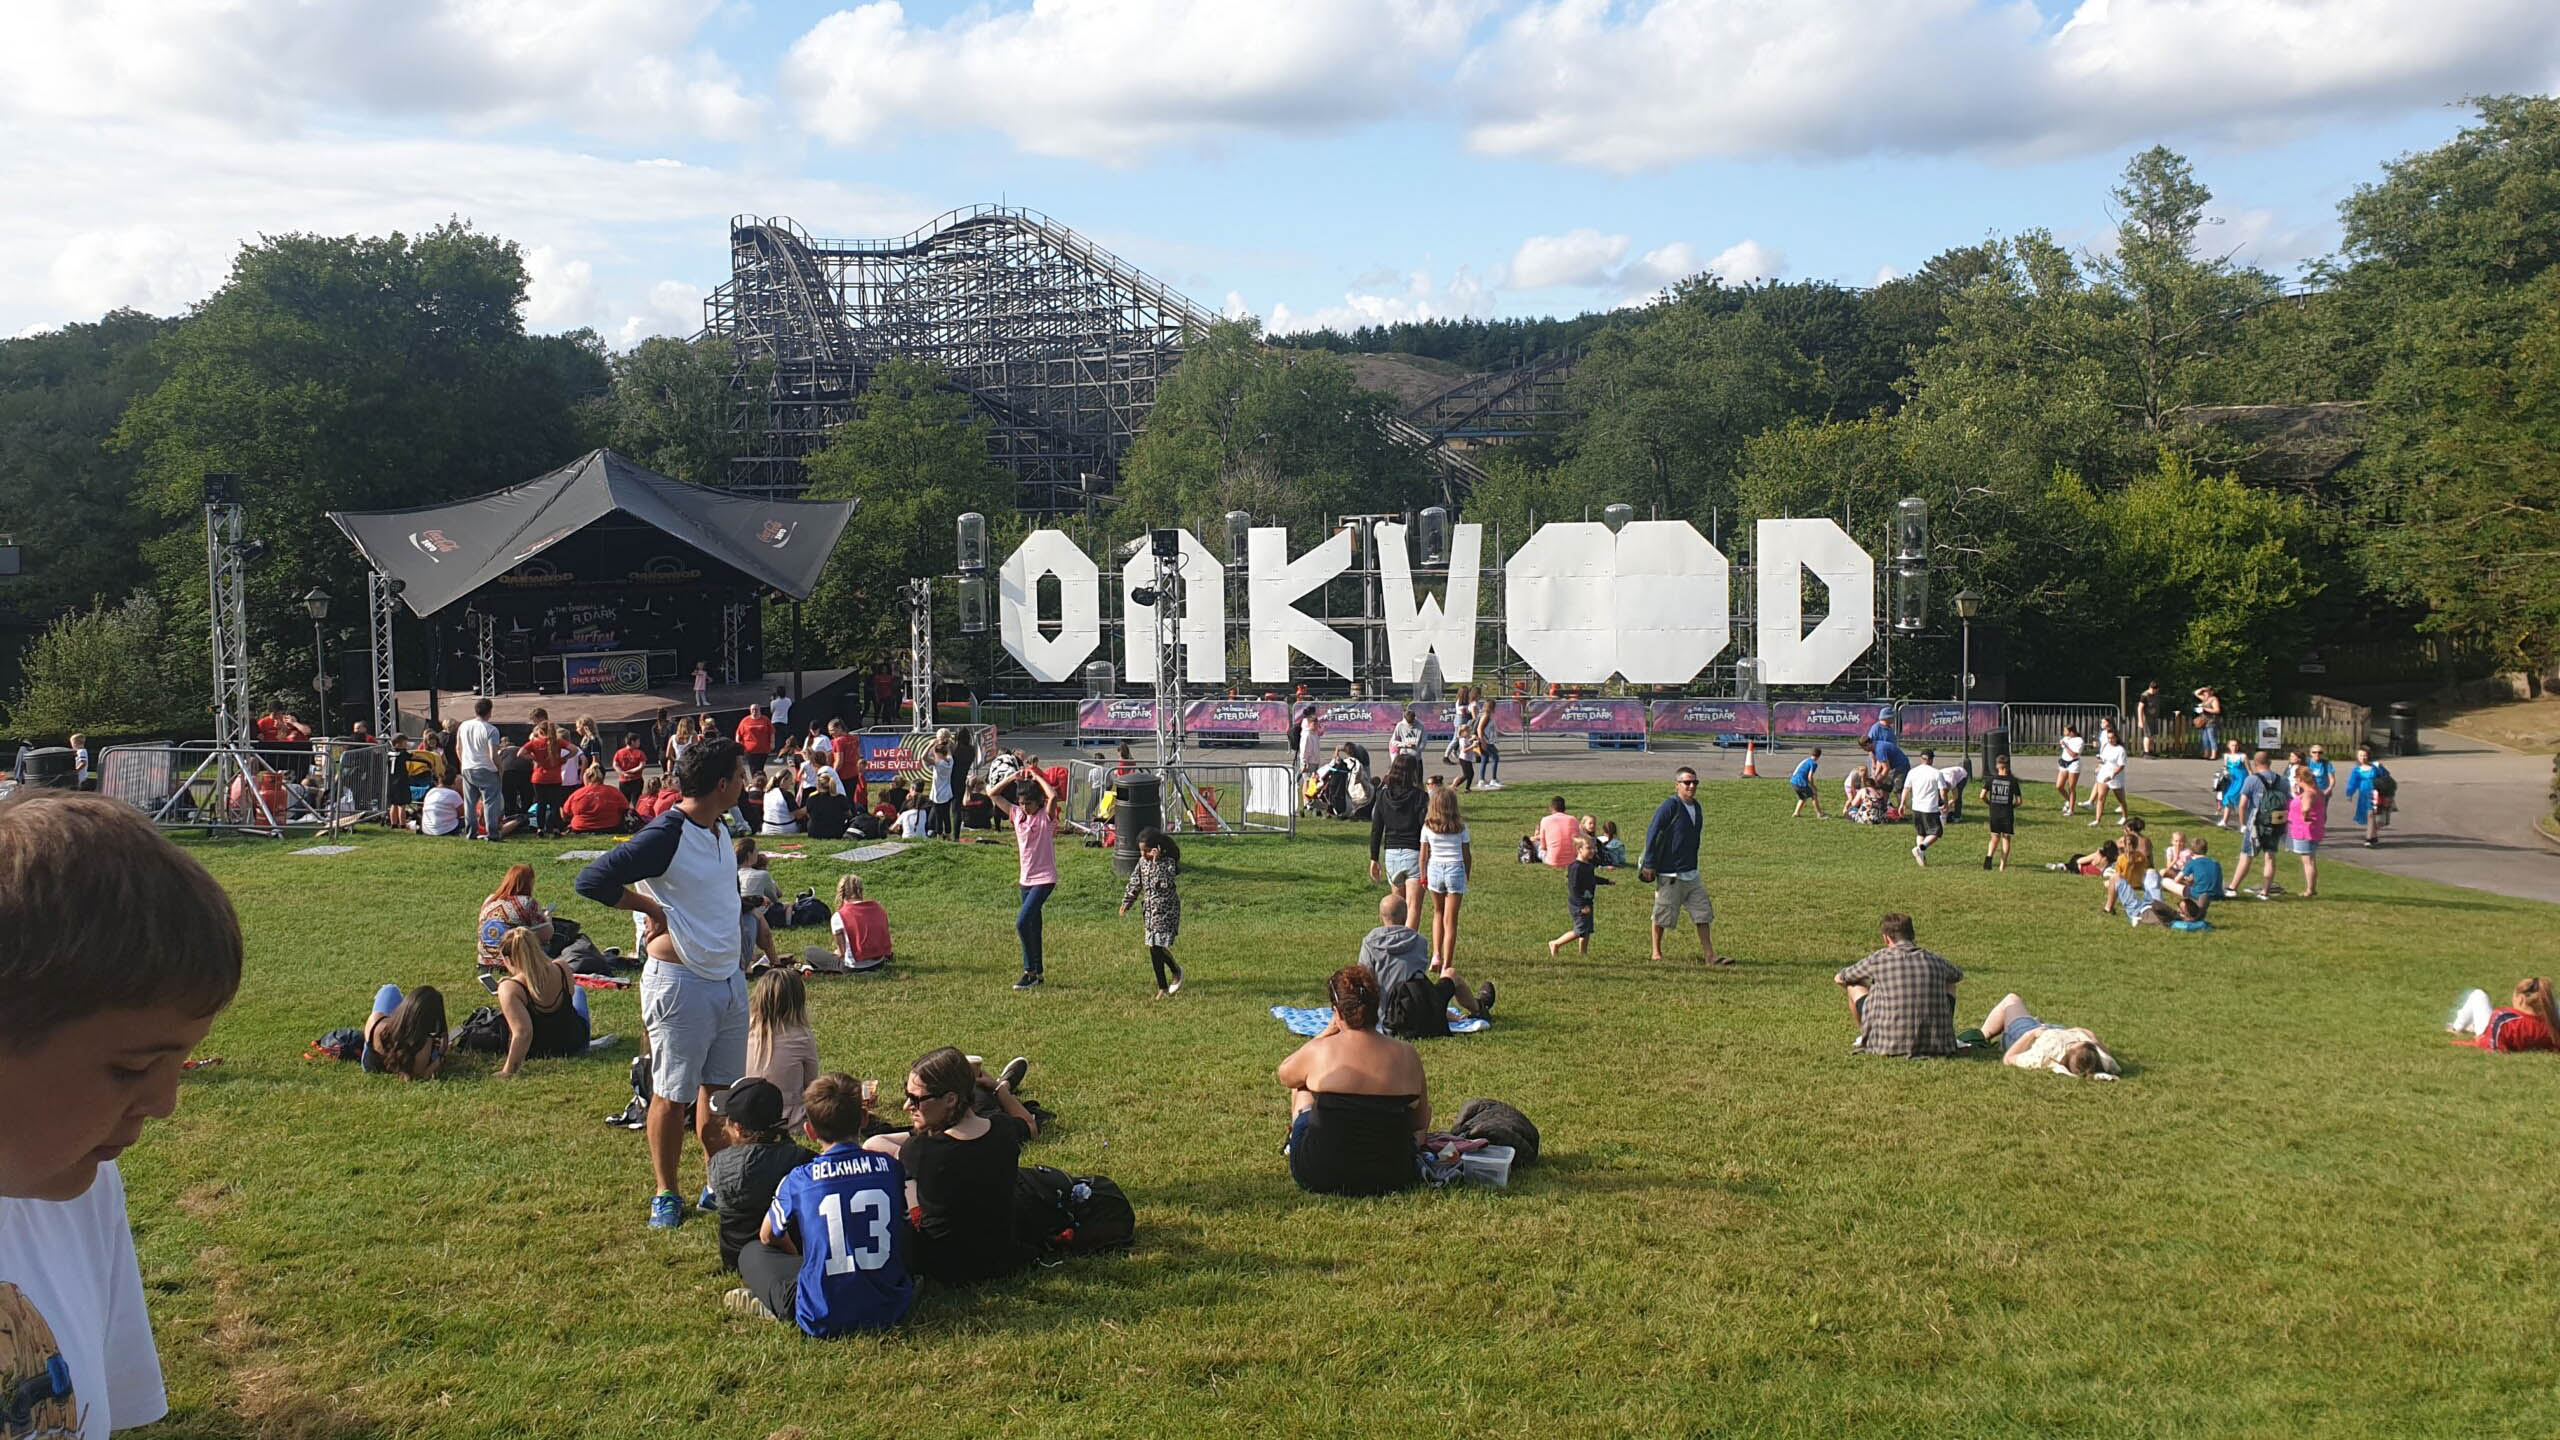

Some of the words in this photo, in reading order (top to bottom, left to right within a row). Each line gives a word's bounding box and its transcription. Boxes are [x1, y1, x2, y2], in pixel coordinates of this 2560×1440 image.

[1000, 518, 1874, 686] OAKWOOD
[579, 667, 597, 676] LIVE
[598, 666, 609, 674] AT
[590, 675, 617, 684] EVENT
[1107, 711, 1131, 719] AFTER
[1131, 709, 1153, 719] DARK
[1213, 712, 1237, 720] AFTER
[1238, 711, 1260, 721] DARK
[1350, 711, 1372, 722] DARK
[1439, 713, 1456, 722] AFT
[1561, 712, 1588, 720] AFTER
[1589, 711, 1613, 721] DARK
[1683, 712, 1711, 721] AFTER
[1711, 711, 1736, 722] DARK
[1807, 714, 1834, 723] AFTER
[1835, 713, 1860, 724] DARK
[873, 748, 894, 758] LIVE
[898, 748, 910, 757] AT
[865, 761, 885, 769] THIS
[887, 760, 920, 769] EVENT
[875, 1156, 889, 1172] JR
[818, 1188, 892, 1276] 13
